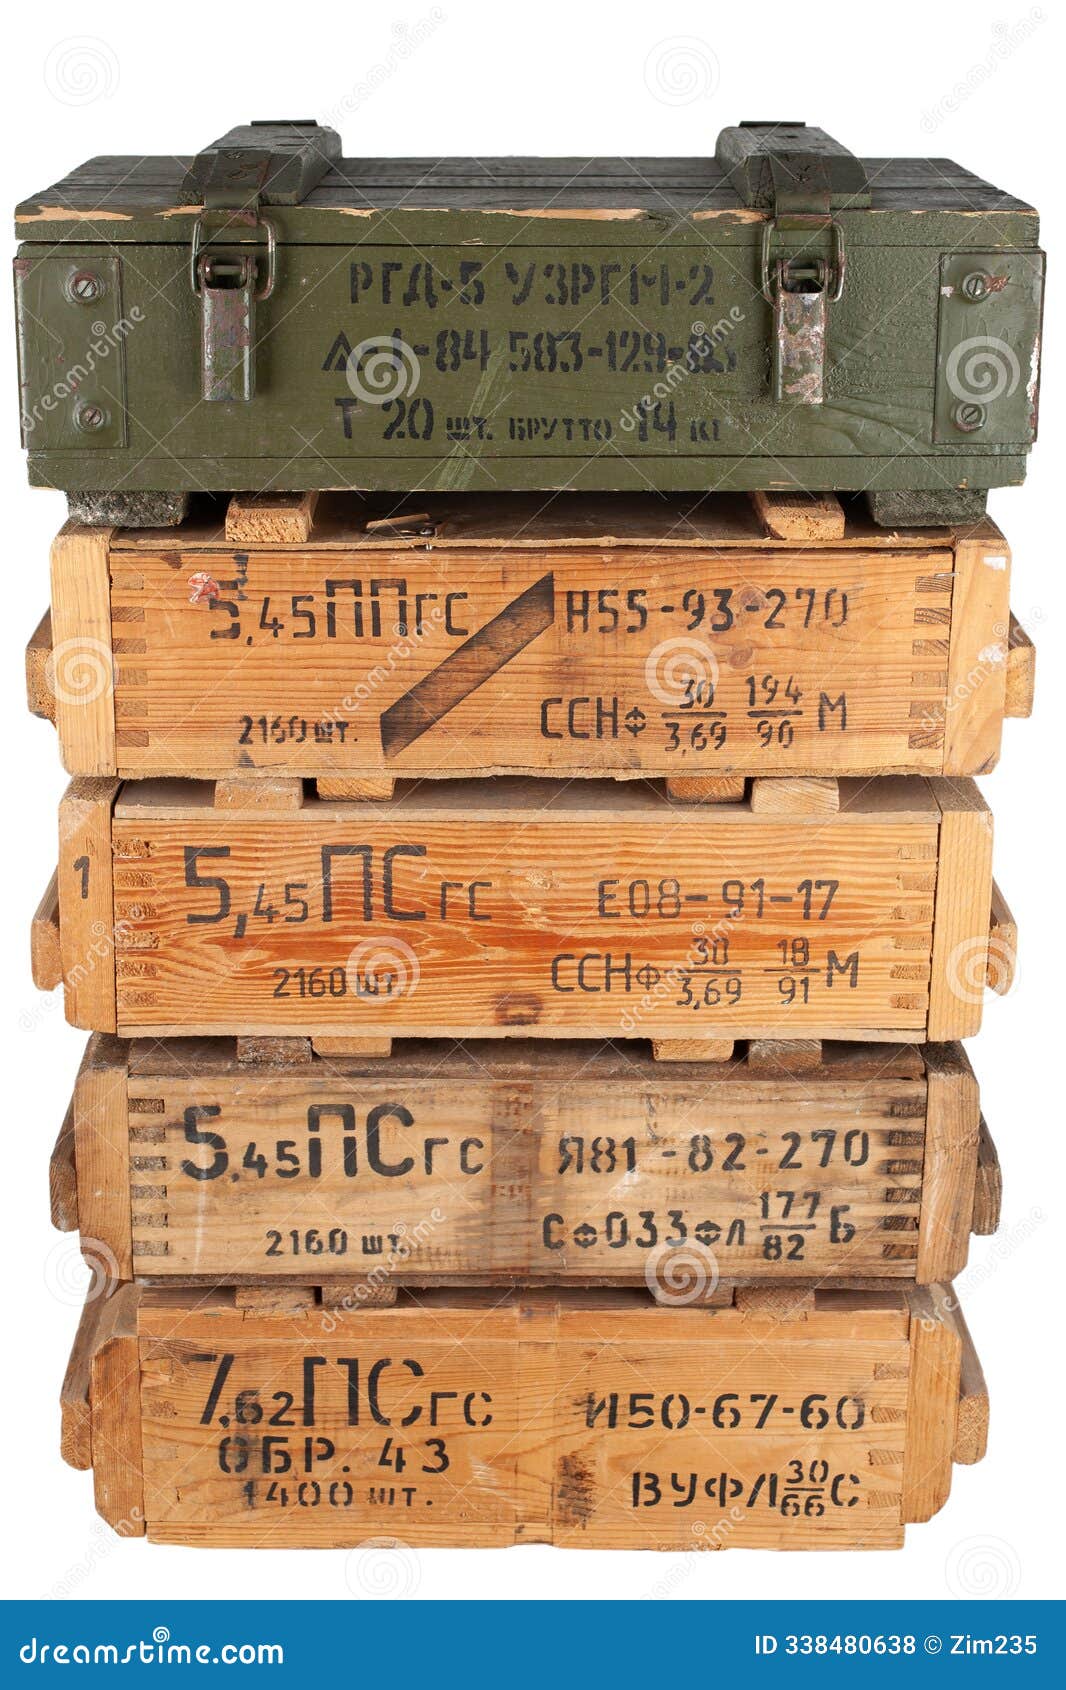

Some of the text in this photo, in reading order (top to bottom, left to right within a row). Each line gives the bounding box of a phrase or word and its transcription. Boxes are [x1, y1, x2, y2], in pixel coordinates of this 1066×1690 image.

[349, 262, 715, 308] РГД-5 УЗРГМ-2
[381, 398, 434, 440] 20
[637, 401, 677, 442] 14
[678, 679, 714, 708] 30
[746, 675, 803, 706] 194
[239, 715, 308, 745] 2160
[757, 720, 794, 749] 90
[73, 855, 90, 899] 1
[692, 937, 729, 965] 30
[777, 936, 810, 967] 18
[272, 966, 347, 998] 2160
[676, 977, 743, 1011] 3,69
[778, 976, 810, 1005] 91
[760, 1191, 822, 1219] 177
[265, 1228, 348, 1257] 2160
[762, 1234, 806, 1261] 82
[378, 1438, 451, 1474] 43
[786, 1460, 830, 1484] 30
[243, 1481, 354, 1508] 1400
[779, 1493, 826, 1517] 66
